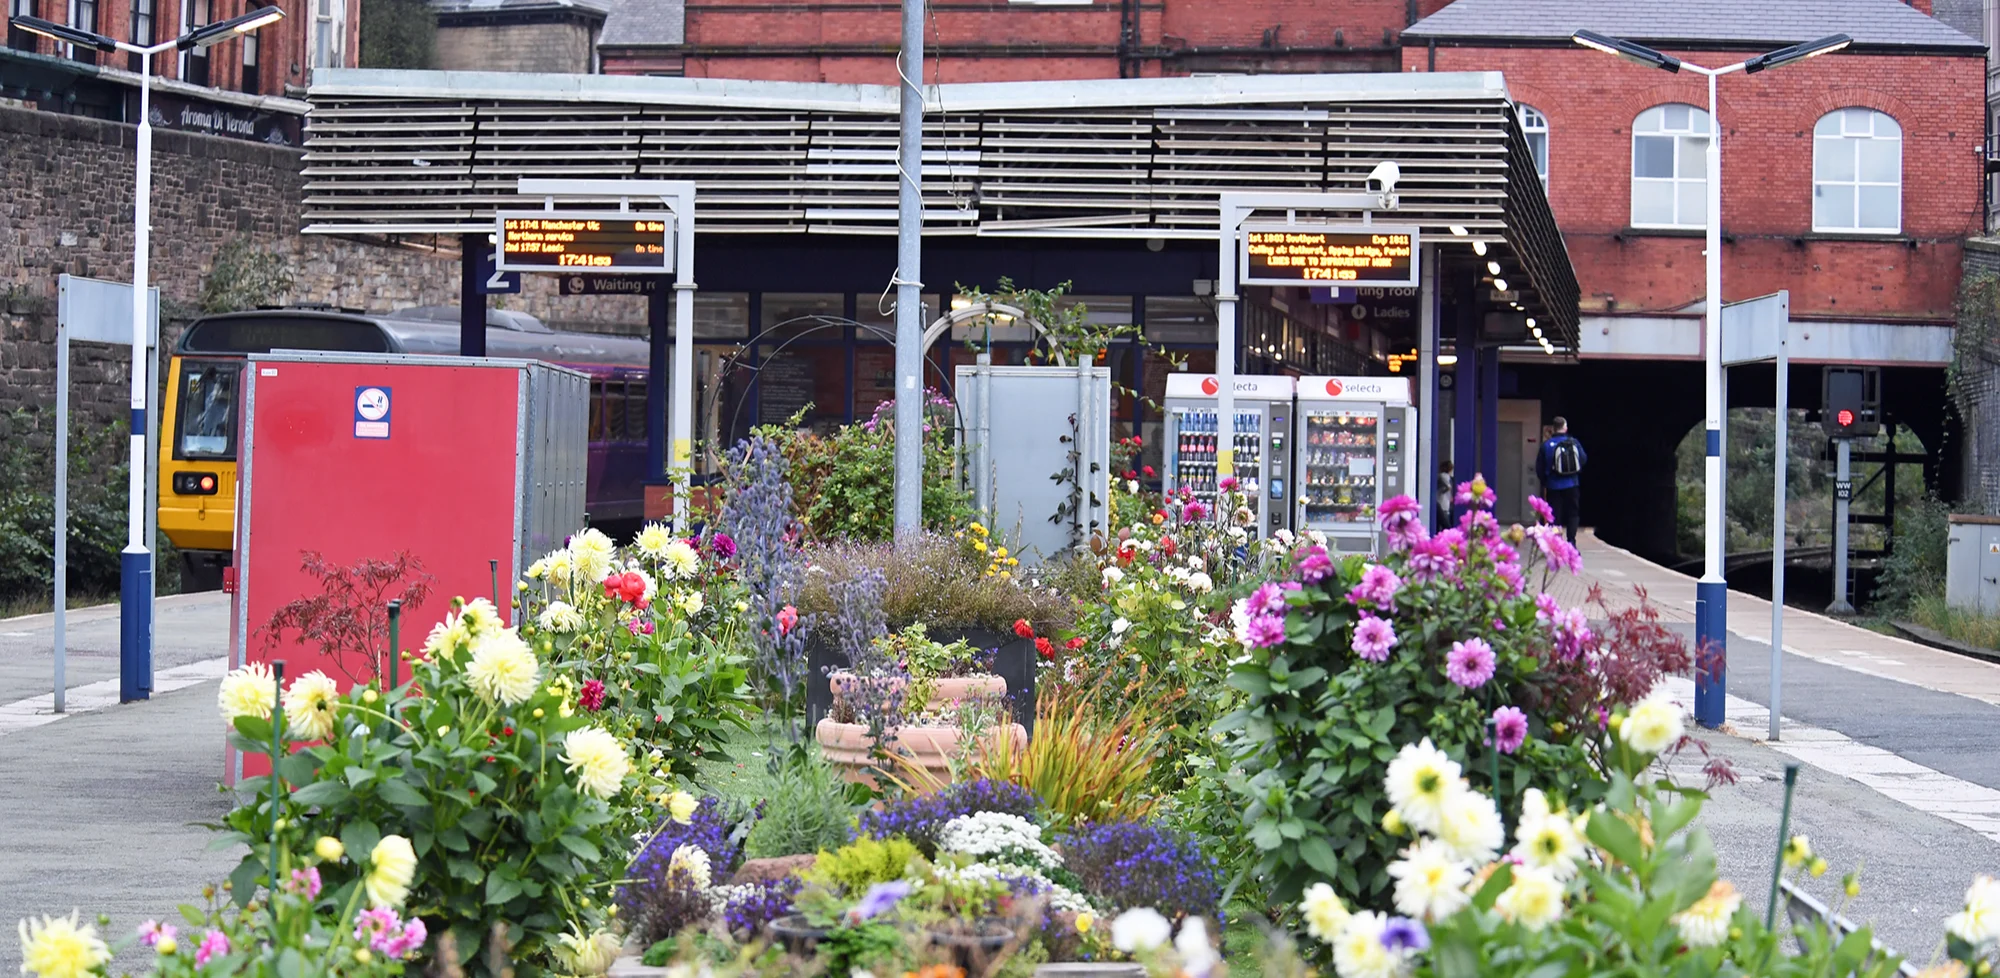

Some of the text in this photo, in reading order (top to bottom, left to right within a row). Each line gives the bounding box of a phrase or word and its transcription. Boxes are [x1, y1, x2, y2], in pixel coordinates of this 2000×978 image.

[181, 104, 254, 134] Aroma Di Verona
[505, 220, 664, 231] 1st 17:41 Manchester Vic On time
[507, 231, 574, 241] Northern service
[1248, 233, 1262, 243] 1st
[1285, 234, 1325, 245] Southport
[1372, 235, 1388, 246] Exp
[505, 242, 519, 252] 2nd
[542, 243, 565, 252] Leeds
[635, 244, 645, 253] On
[647, 244, 664, 253] time
[1248, 244, 1275, 256] Calling
[1291, 256, 1306, 266] DUE
[1307, 257, 1319, 266] TO
[1320, 257, 1371, 267] IMPROVEMENT
[593, 278, 642, 293] Waiting
[1374, 306, 1410, 317] Ladies
[1345, 384, 1382, 393] selecta
